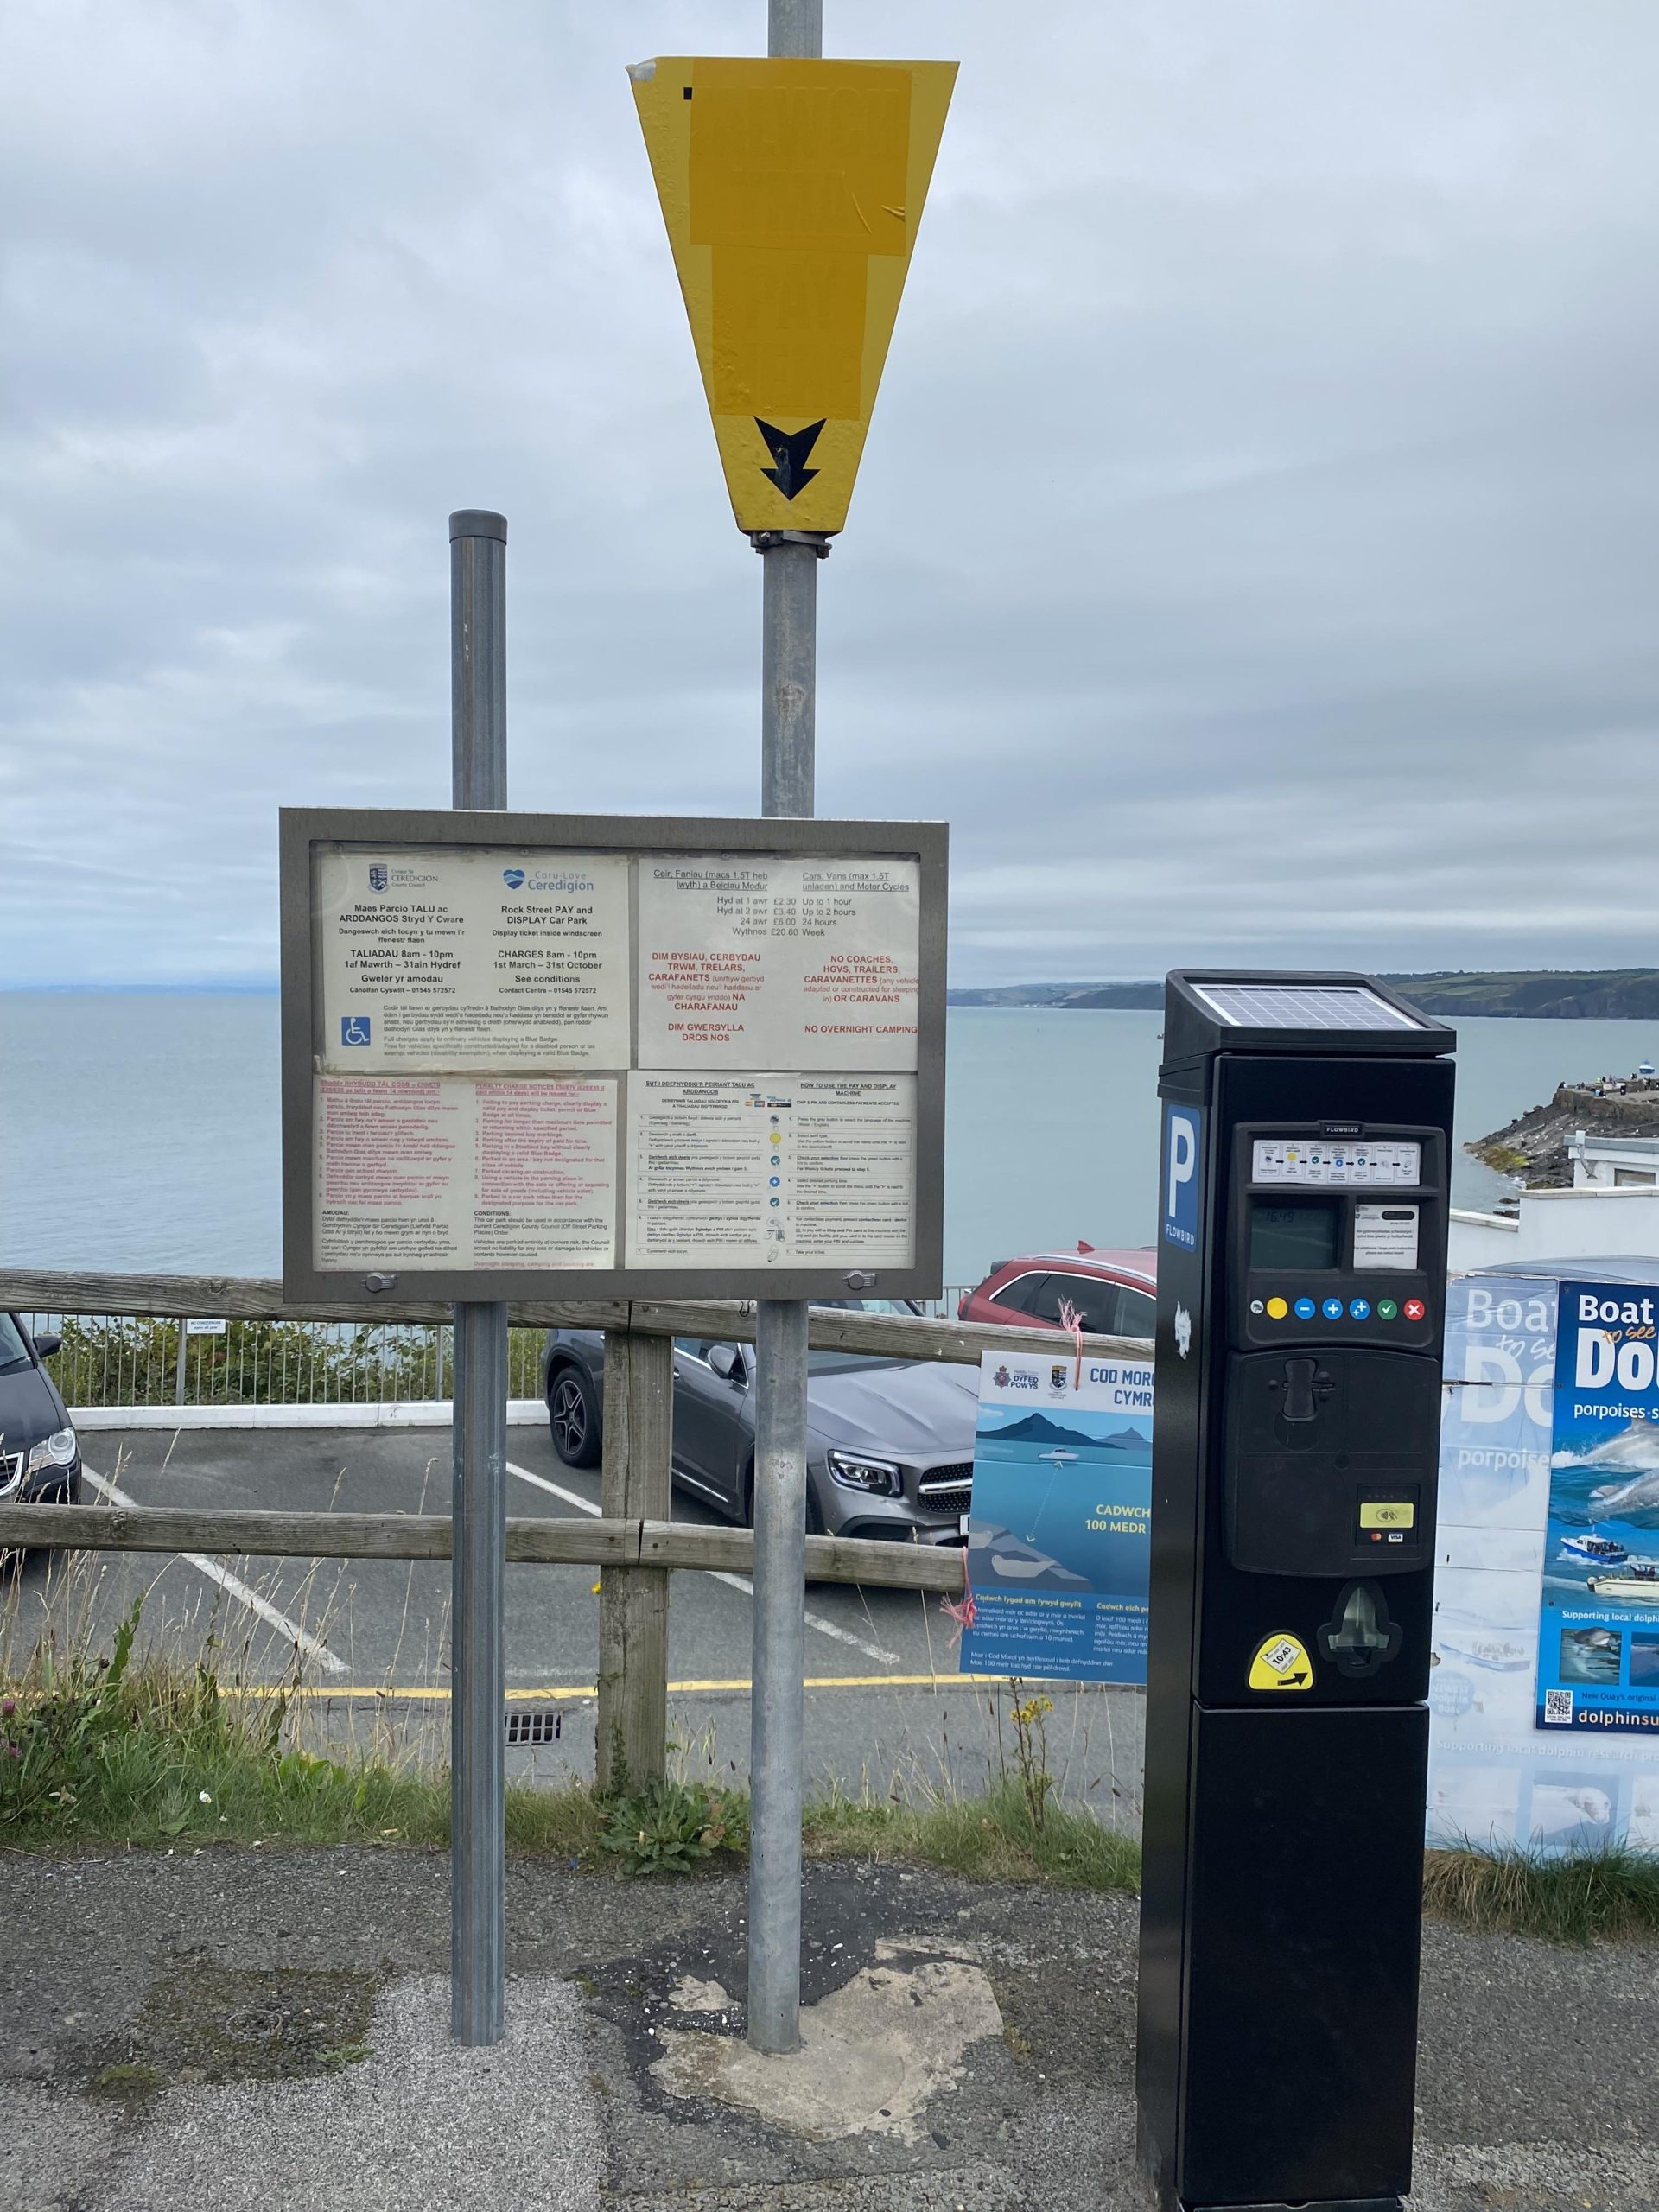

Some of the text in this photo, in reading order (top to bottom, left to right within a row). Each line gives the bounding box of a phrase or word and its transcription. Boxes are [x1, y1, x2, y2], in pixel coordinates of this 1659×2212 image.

[535, 871, 586, 880] Caru-Love
[653, 869, 673, 880] Ceir,
[676, 870, 703, 879] Faniau
[705, 871, 730, 880] (macs
[527, 878, 594, 893] Ceredigion
[677, 880, 700, 889] lwyth)
[717, 896, 734, 906] Hyd
[773, 897, 797, 906] £2.30
[802, 898, 814, 906] Up
[354, 904, 378, 912] Maes
[379, 904, 408, 912] Parcio
[526, 906, 553, 914] Street
[555, 906, 574, 914] PAY
[717, 906, 733, 916] Hyd
[773, 907, 797, 916] £3.40
[802, 908, 814, 917] Up
[826, 907, 831, 916] 2
[339, 914, 399, 923] ARDDANGOS
[401, 915, 425, 925] Stryd
[507, 916, 588, 925] DISPLAY Car Park
[740, 917, 750, 925] 24
[802, 918, 812, 926] 24
[732, 927, 767, 937] Wythnos
[802, 928, 825, 937] Week
[429, 950, 454, 959] 10pm
[574, 950, 597, 960] 10pm
[671, 952, 707, 962] BYSIAU,
[709, 953, 760, 962] CERBYDAU
[846, 955, 893, 964] COACHES,
[430, 961, 461, 970] Hydref
[567, 961, 602, 969] October
[667, 963, 745, 972] TRWM, TRELARS,
[823, 965, 900, 975] HGVS, TRAILERS,
[361, 974, 393, 982] Gweler
[534, 975, 581, 983] conditions
[648, 973, 710, 982] CARAFANETS
[804, 975, 878, 983] CARAVANETTES
[674, 1002, 738, 1011] CHARAFANAU
[686, 1023, 745, 1032] GWERSYLLA
[804, 1025, 818, 1033] NO
[820, 1025, 874, 1033] OVERNIGHT
[682, 1033, 730, 1042] DROS NOS
[1168, 1116, 1196, 1218] P
[1166, 1224, 1194, 1246] FLOWBIRD
[1579, 1294, 1654, 1324] Boat
[1603, 1326, 1656, 1344] to see
[1576, 1327, 1659, 1391] Do
[1114, 1389, 1154, 1407] CYMR
[1574, 1403, 1645, 1420] porpoises
[1459, 1448, 1550, 1471] porpoise
[1096, 1504, 1151, 1518] CADWCH
[1085, 1520, 1146, 1534] 100 MEDR
[976, 1593, 1002, 1603] Cadwch
[1004, 1596, 1023, 1605] lygad
[1038, 1599, 1058, 1607] fywyd
[1059, 1599, 1082, 1609] gwyllt
[1634, 1614, 1659, 1624] dolphi
[1272, 1647, 1291, 1664] 10:43
[1627, 1694, 1656, 1702] original
[1578, 1709, 1659, 1726] dolphinsu
